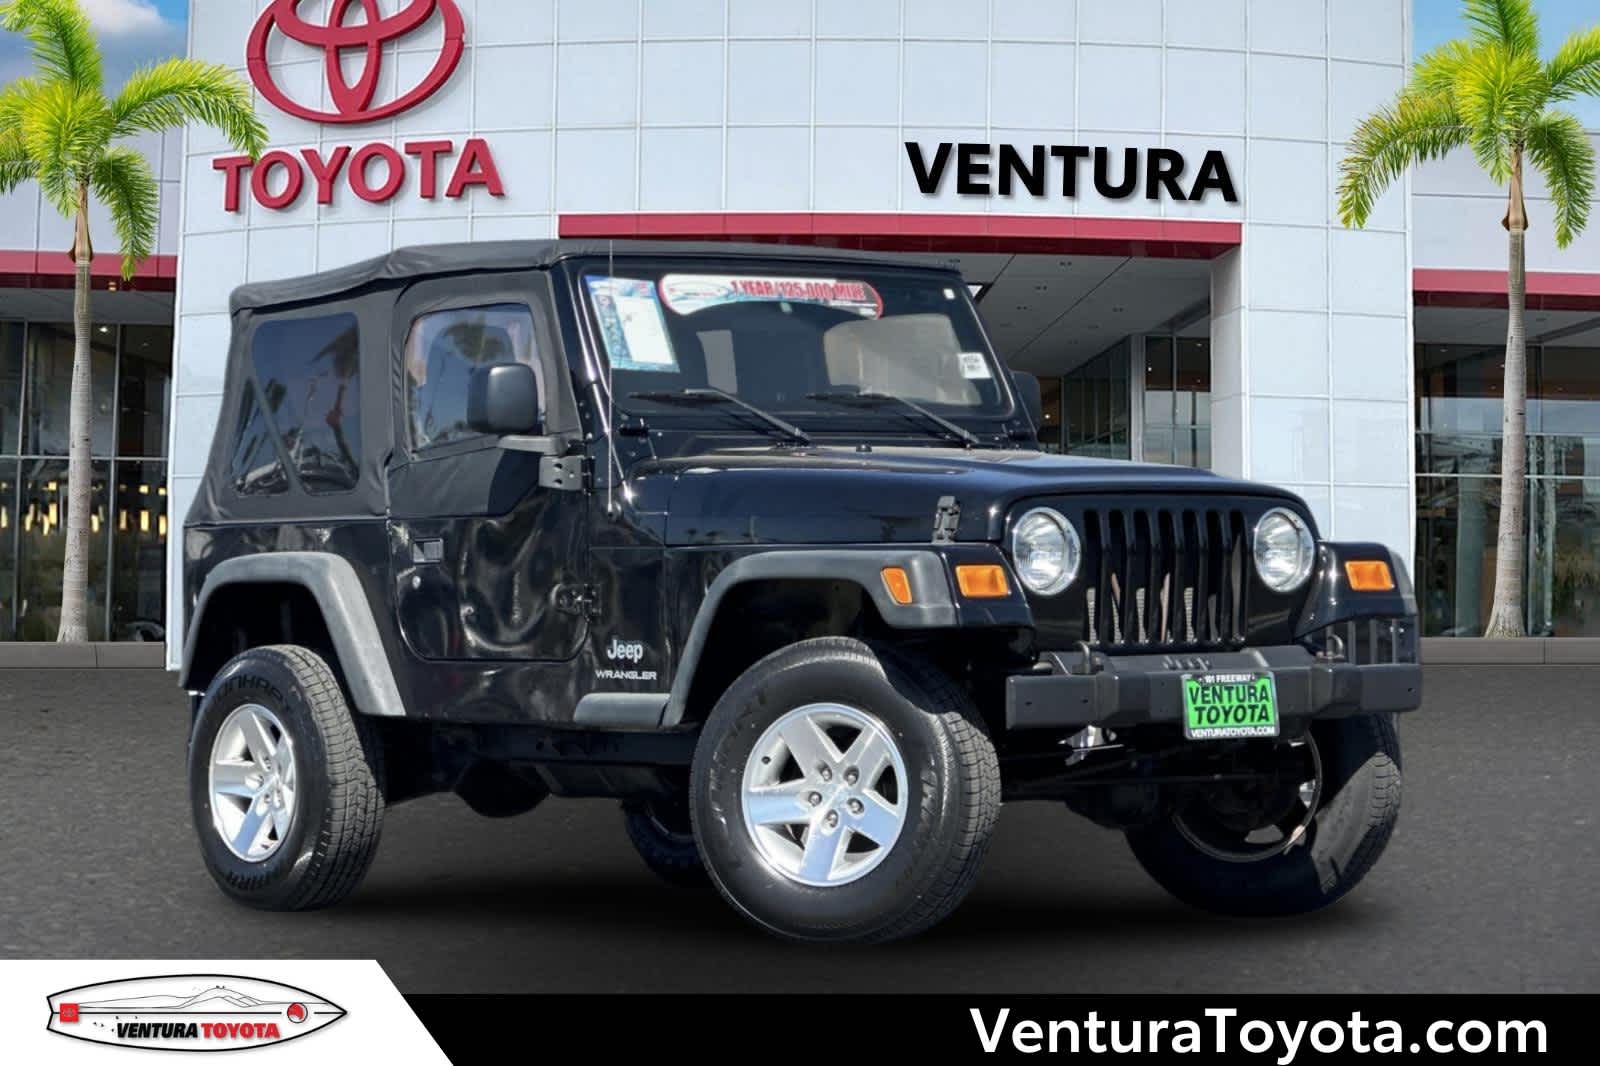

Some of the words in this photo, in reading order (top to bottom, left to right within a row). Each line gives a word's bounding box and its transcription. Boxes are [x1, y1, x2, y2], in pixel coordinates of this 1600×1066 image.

[213, 139, 504, 212] TOYOTA
[904, 142, 1238, 202] VENTURA
[607, 638, 643, 663] Jeep
[595, 670, 657, 680] WRANGLER
[1216, 674, 1251, 683] FREEWAY
[1189, 685, 1269, 704] VENTURA
[1194, 704, 1270, 724] TOYOTA
[1191, 726, 1275, 738] VENTURATOYOTA.COM
